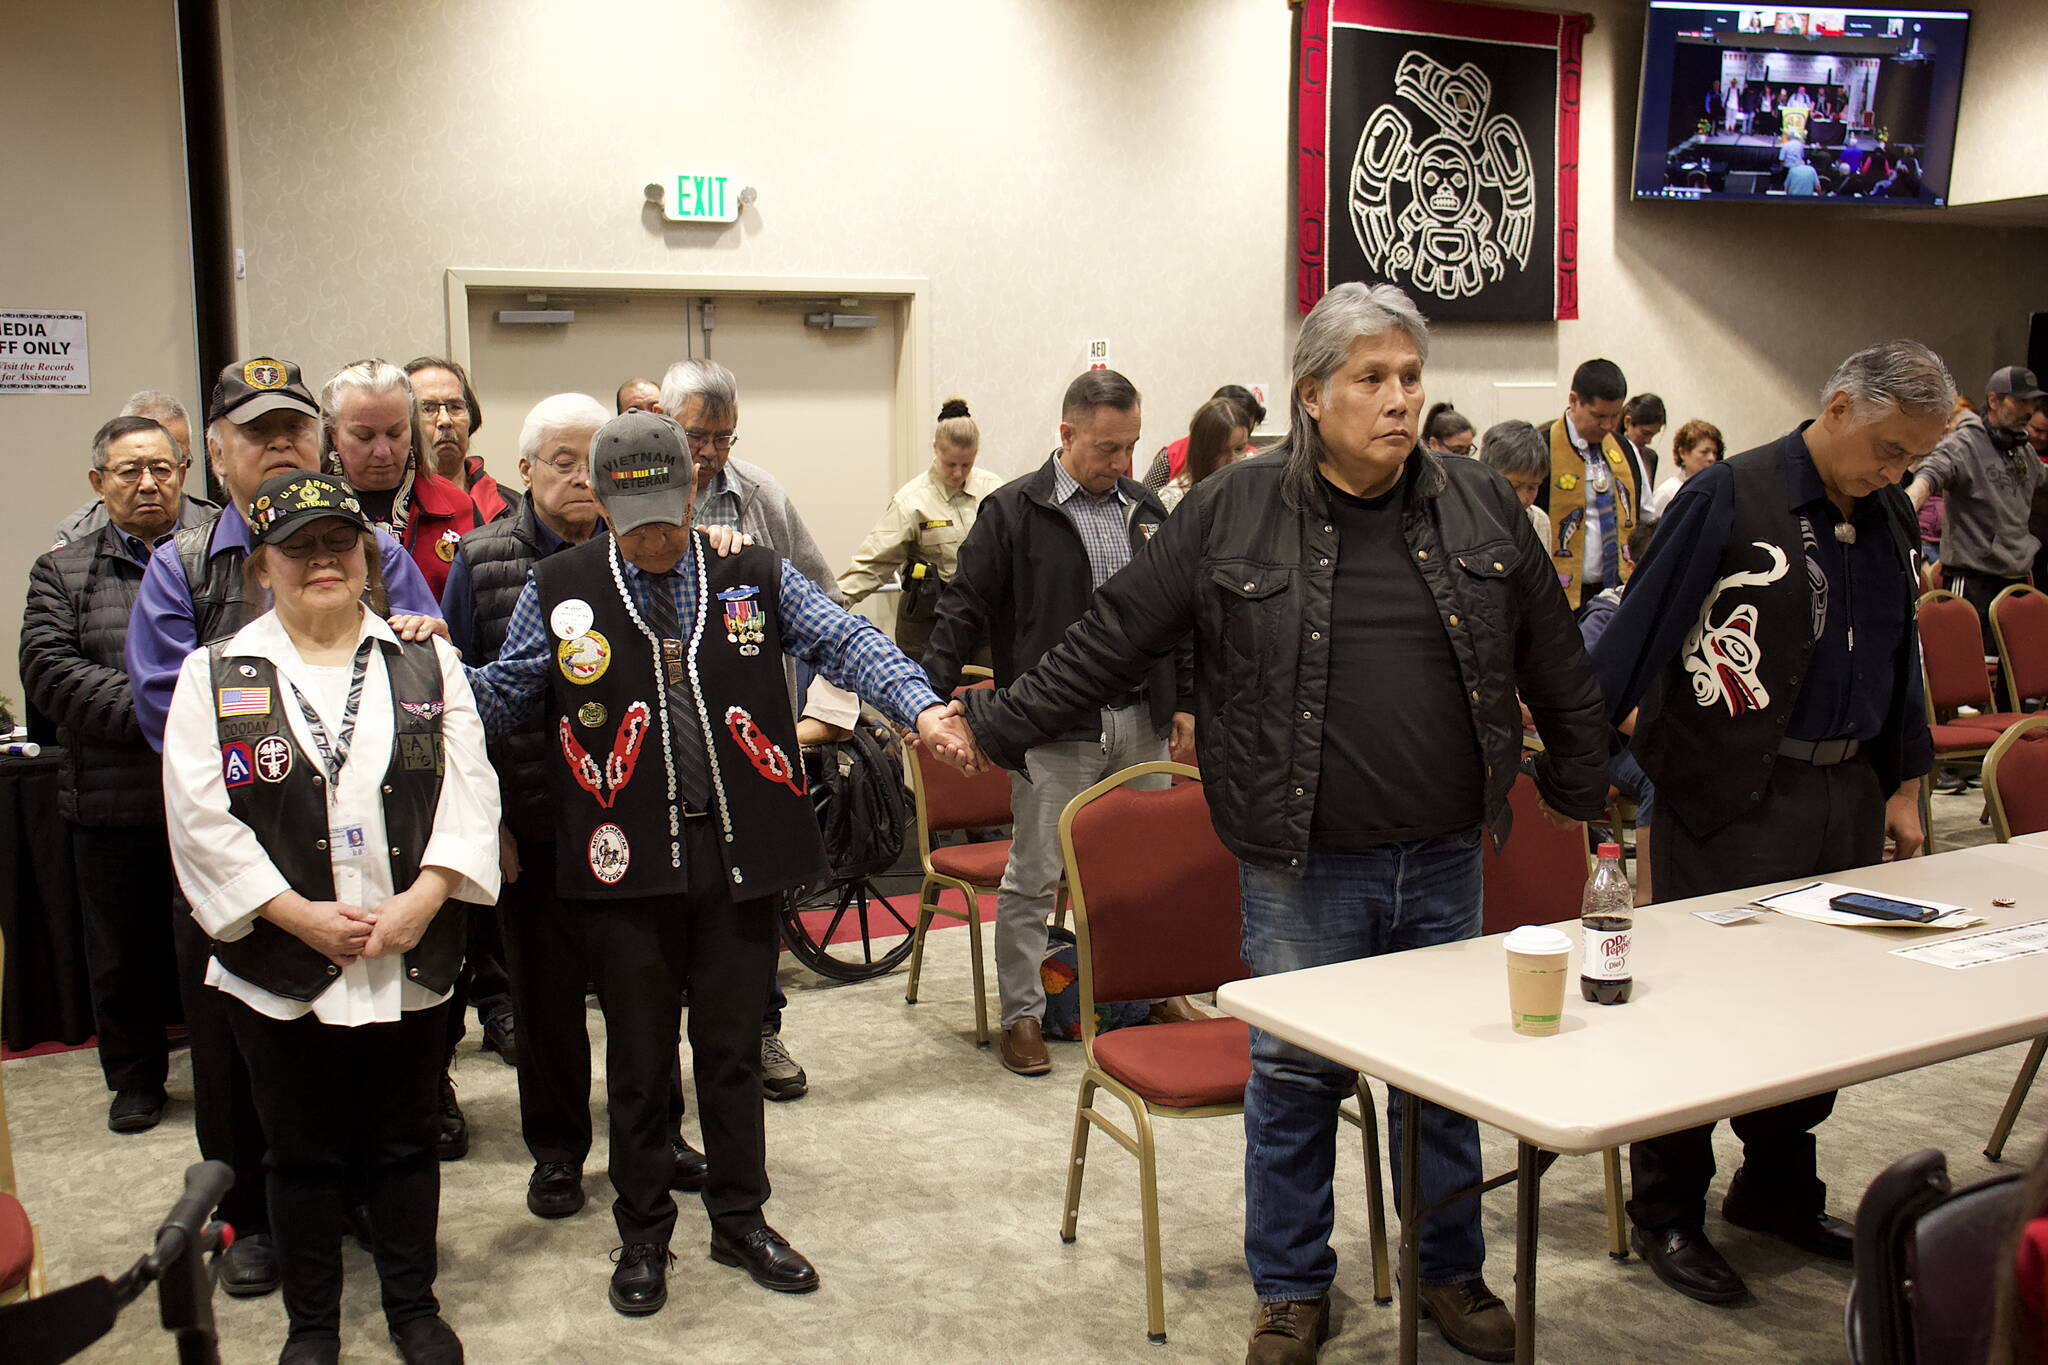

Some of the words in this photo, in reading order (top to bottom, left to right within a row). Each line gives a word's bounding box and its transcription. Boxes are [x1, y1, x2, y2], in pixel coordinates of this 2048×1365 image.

[678, 176, 727, 216] EXIT
[0, 323, 47, 336] EDIA
[23, 341, 71, 355] ONLY
[1091, 341, 1106, 357] AED
[20, 362, 35, 371] the
[38, 362, 74, 371] Records
[2, 372, 16, 382] for
[20, 373, 67, 381] Assistance
[603, 452, 675, 472] VIETNAM
[613, 474, 670, 490] VETERAN
[280, 483, 301, 499] U.S.
[305, 479, 336, 493] ARMY
[295, 500, 330, 510] VETERAN
[412, 735, 424, 752] A
[231, 767, 241, 780] 5
[592, 829, 604, 849] NATIVE
[605, 826, 627, 850] AMERICAN
[597, 871, 623, 882] VETERAN
[1615, 935, 1627, 946] Dr
[1609, 960, 1622, 970] Diet
